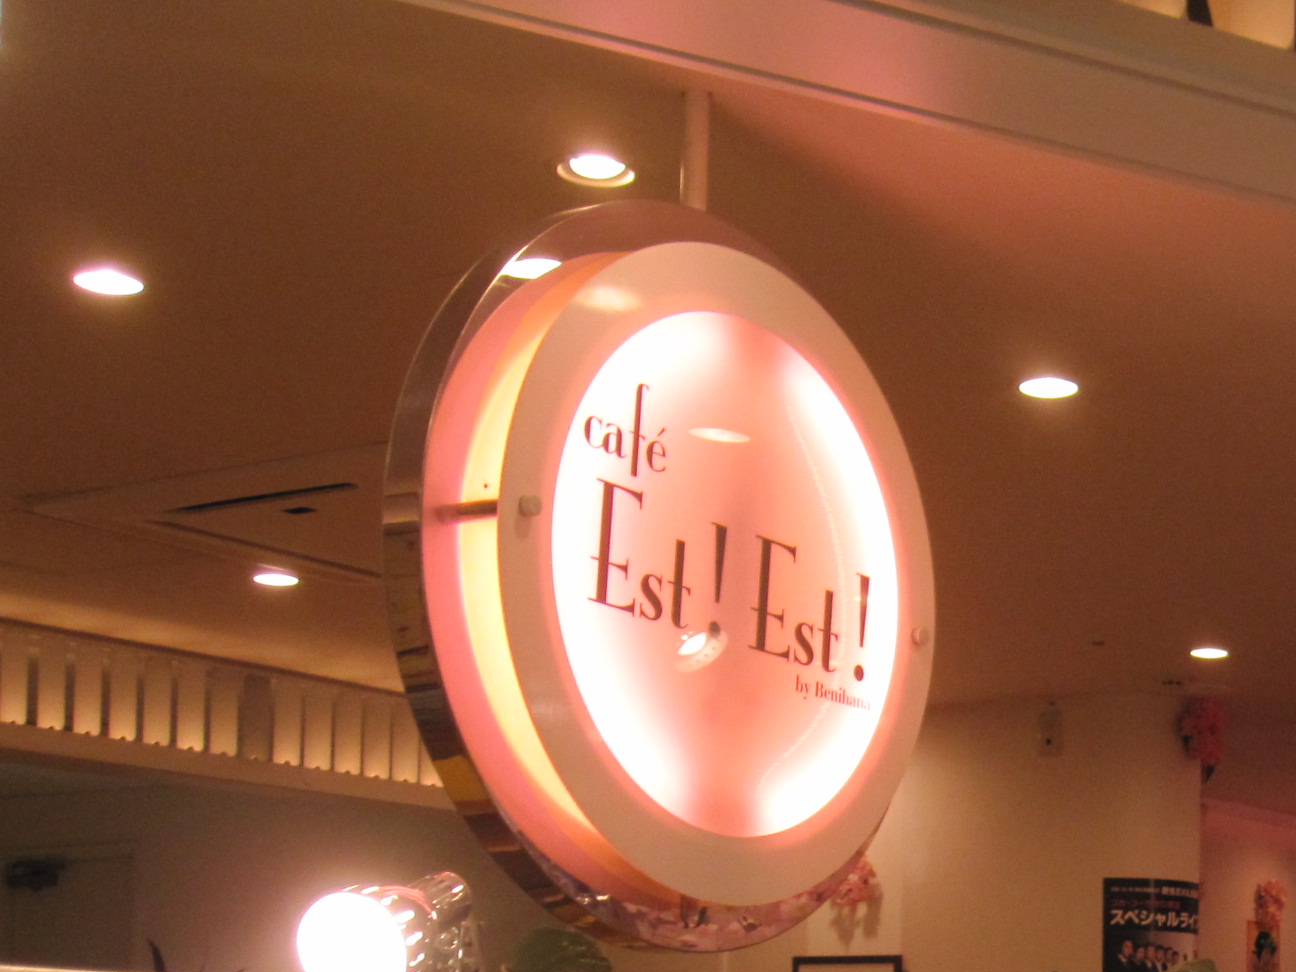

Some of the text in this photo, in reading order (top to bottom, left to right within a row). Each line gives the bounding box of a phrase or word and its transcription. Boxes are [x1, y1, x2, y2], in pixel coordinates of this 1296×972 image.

[584, 383, 667, 477] café
[587, 477, 871, 682] Est! Est!
[795, 675, 871, 711] by Benihana
